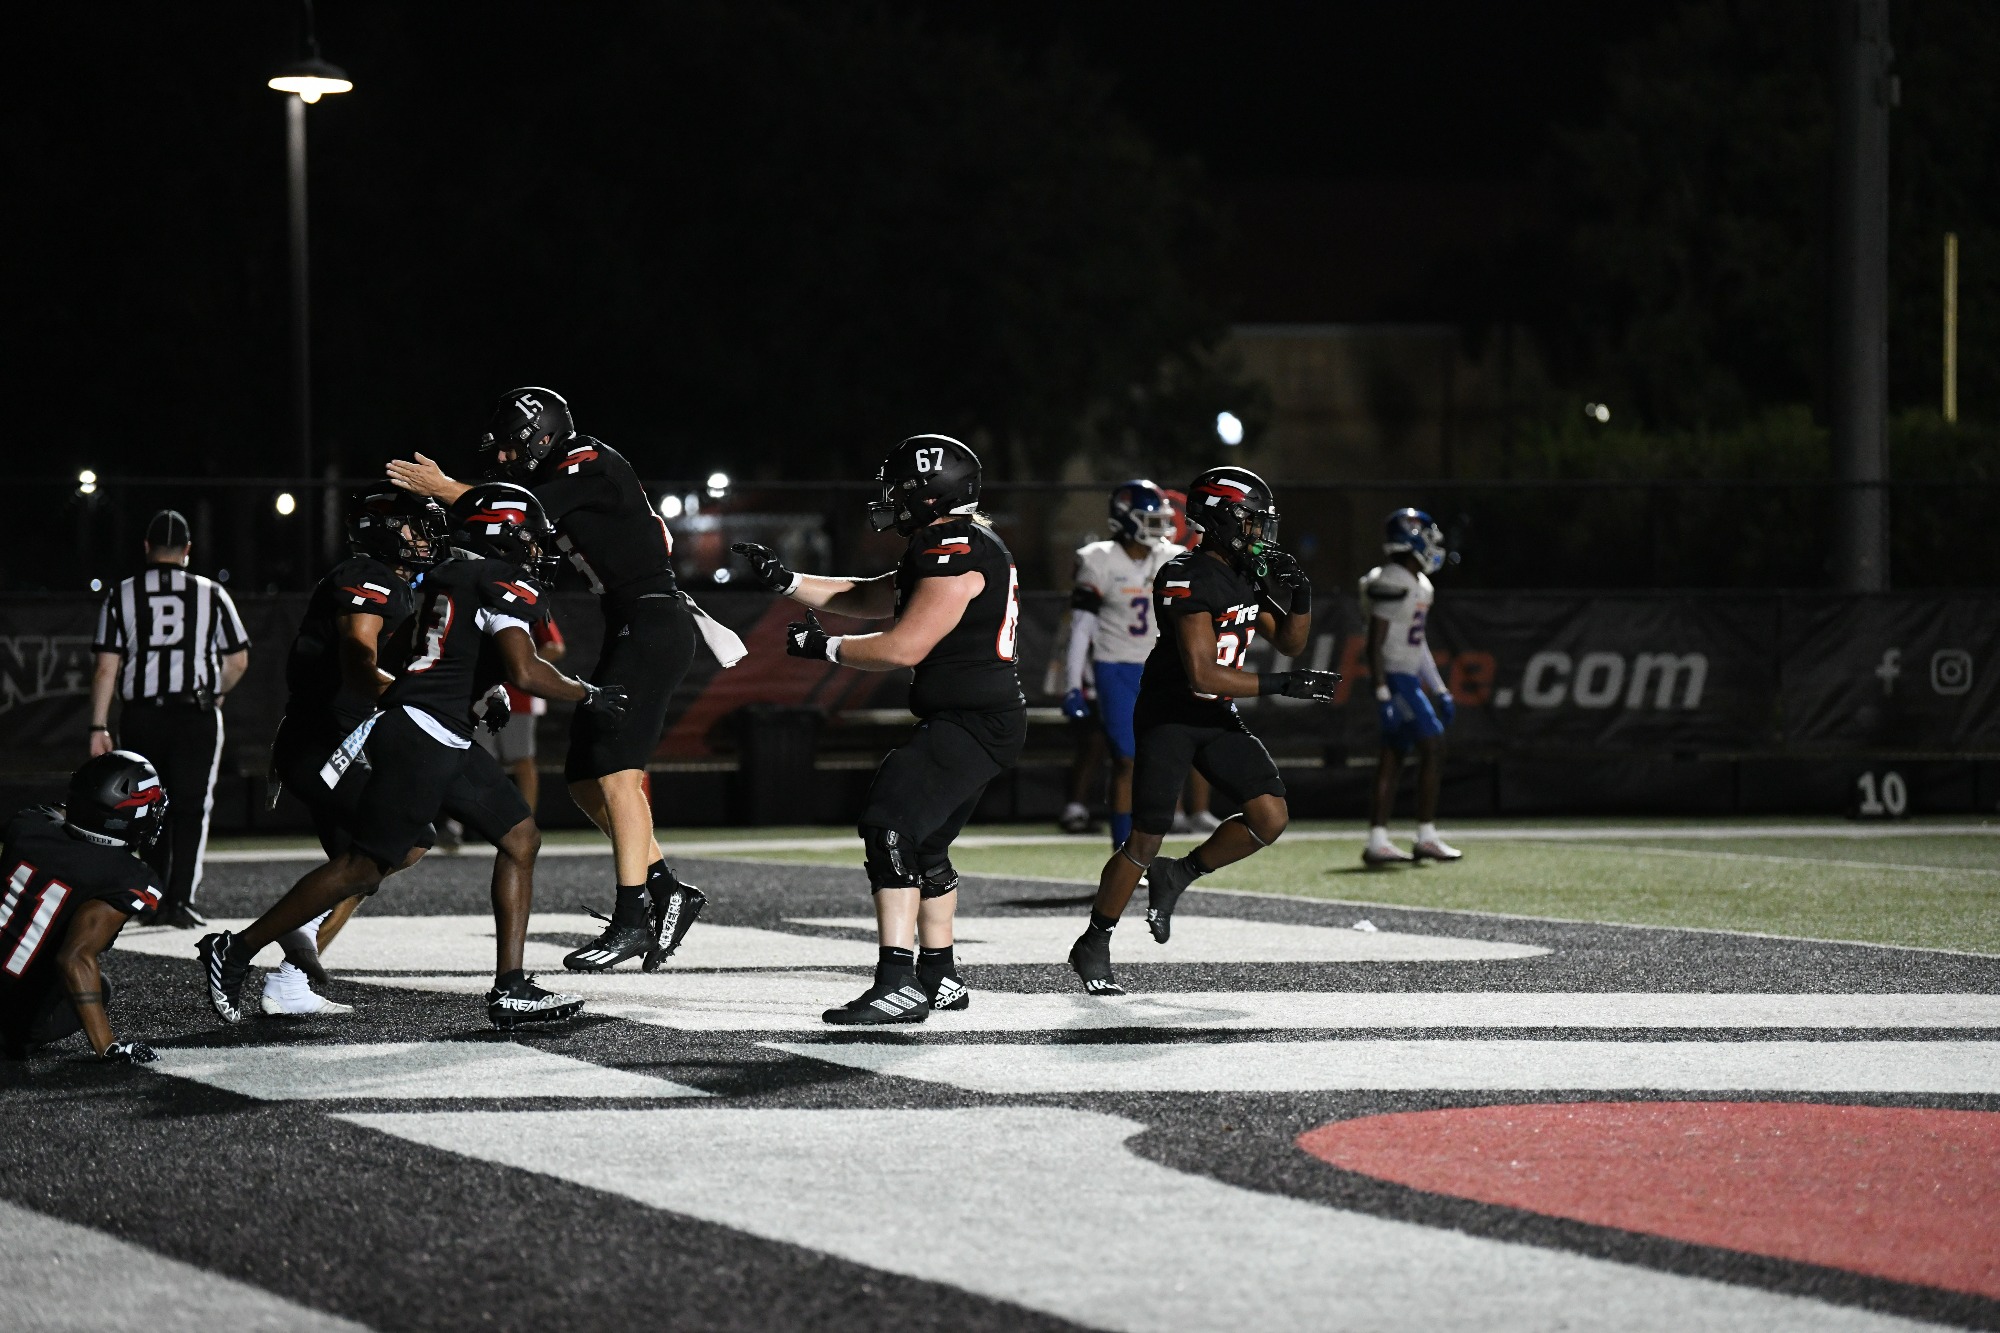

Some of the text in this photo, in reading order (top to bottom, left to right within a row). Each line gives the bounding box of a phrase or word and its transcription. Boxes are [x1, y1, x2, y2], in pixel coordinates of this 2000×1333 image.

[515, 394, 544, 419] 15
[915, 448, 944, 472] 67
[149, 595, 185, 647] B
[1129, 597, 1149, 635] 3
[1857, 770, 1908, 816] 10
[0, 860, 73, 979] 11
